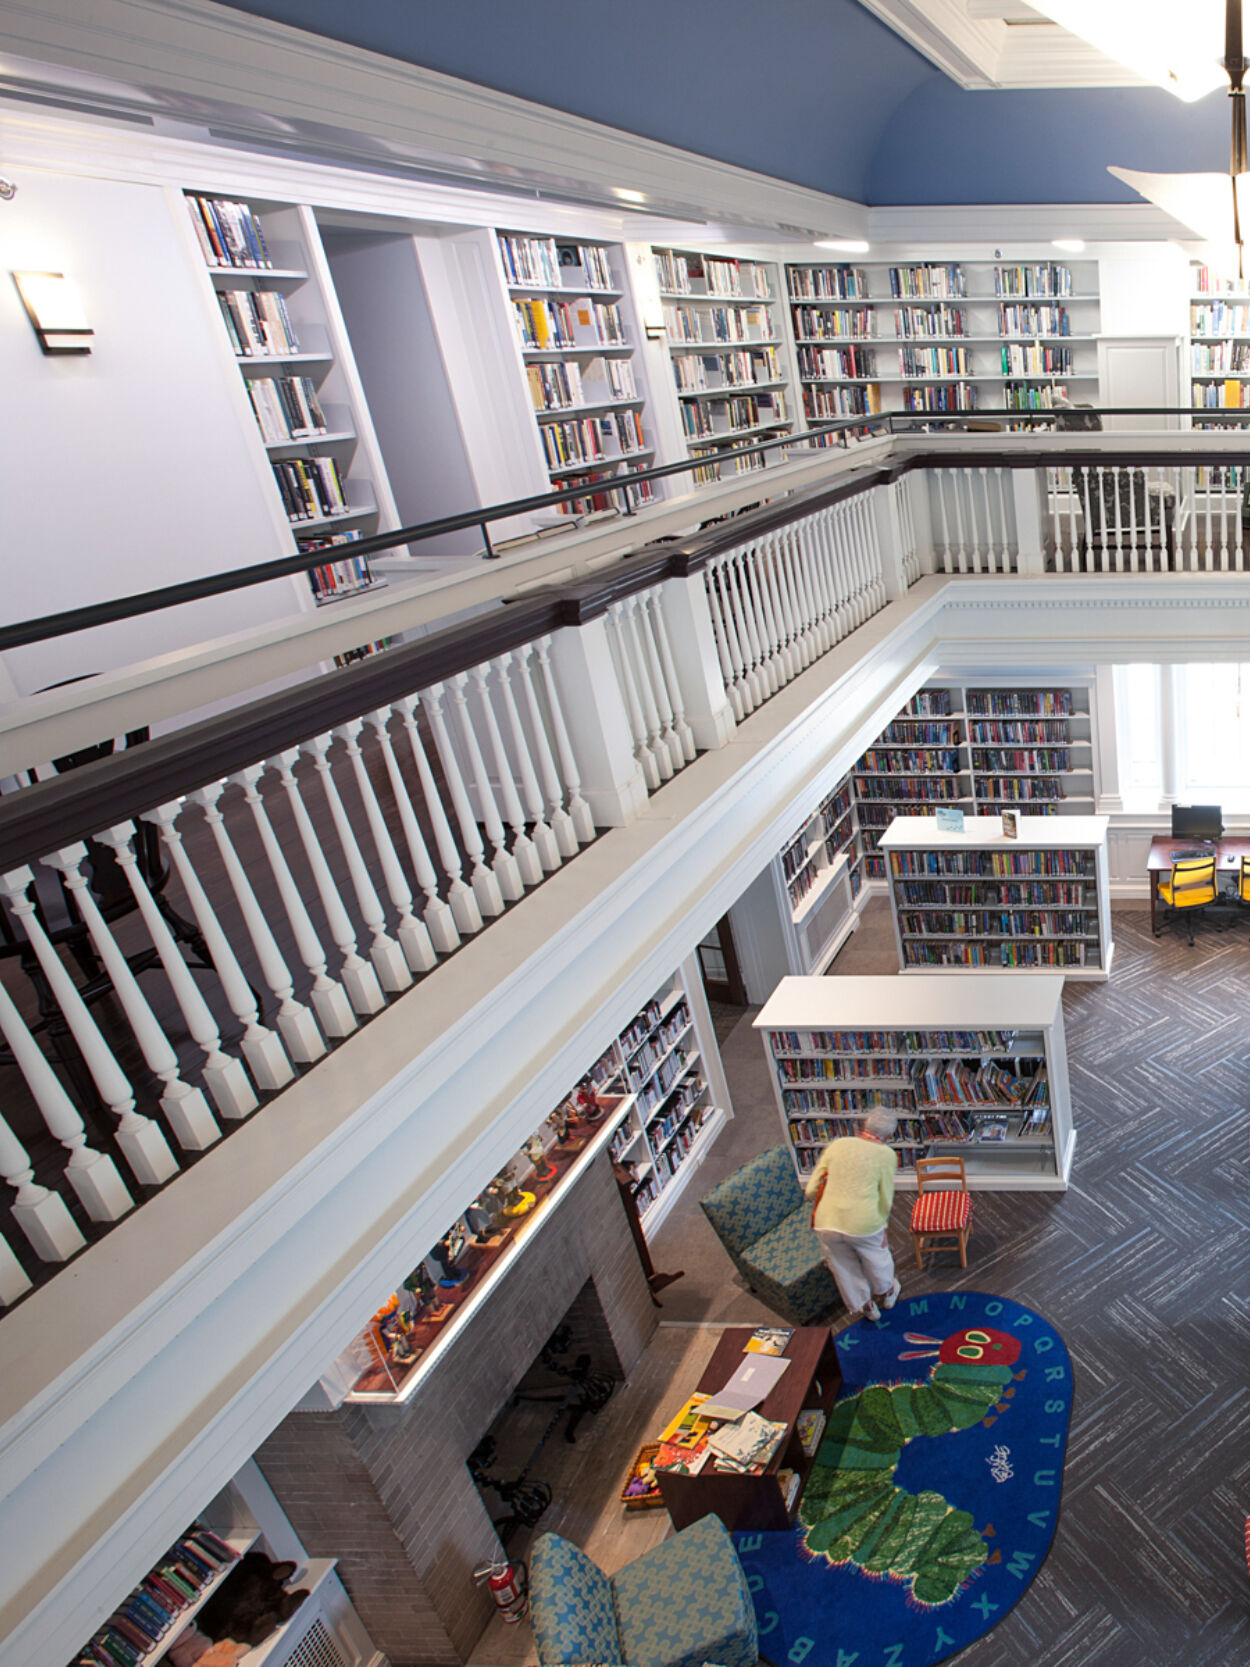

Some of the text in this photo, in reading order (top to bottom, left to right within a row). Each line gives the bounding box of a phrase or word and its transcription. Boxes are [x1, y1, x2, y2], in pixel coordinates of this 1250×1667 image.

[909, 1299, 930, 1316] M
[950, 1295, 968, 1310] N
[985, 1301, 1004, 1316] O
[1013, 1313, 1034, 1327] P
[836, 1332, 861, 1351] K
[1033, 1336, 1054, 1355] Q
[1044, 1365, 1065, 1384] R
[1044, 1399, 1065, 1413] S
[1039, 1432, 1061, 1448] T
[1033, 1469, 1056, 1486] U
[1026, 1510, 1051, 1529] V
[739, 1533, 763, 1553] E
[1006, 1551, 1036, 1580] W
[970, 1591, 999, 1620] X
[757, 1611, 780, 1635] C
[932, 1626, 955, 1652] Y
[787, 1636, 815, 1664] B
[836, 1648, 861, 1667] A
[883, 1643, 905, 1667] Z
